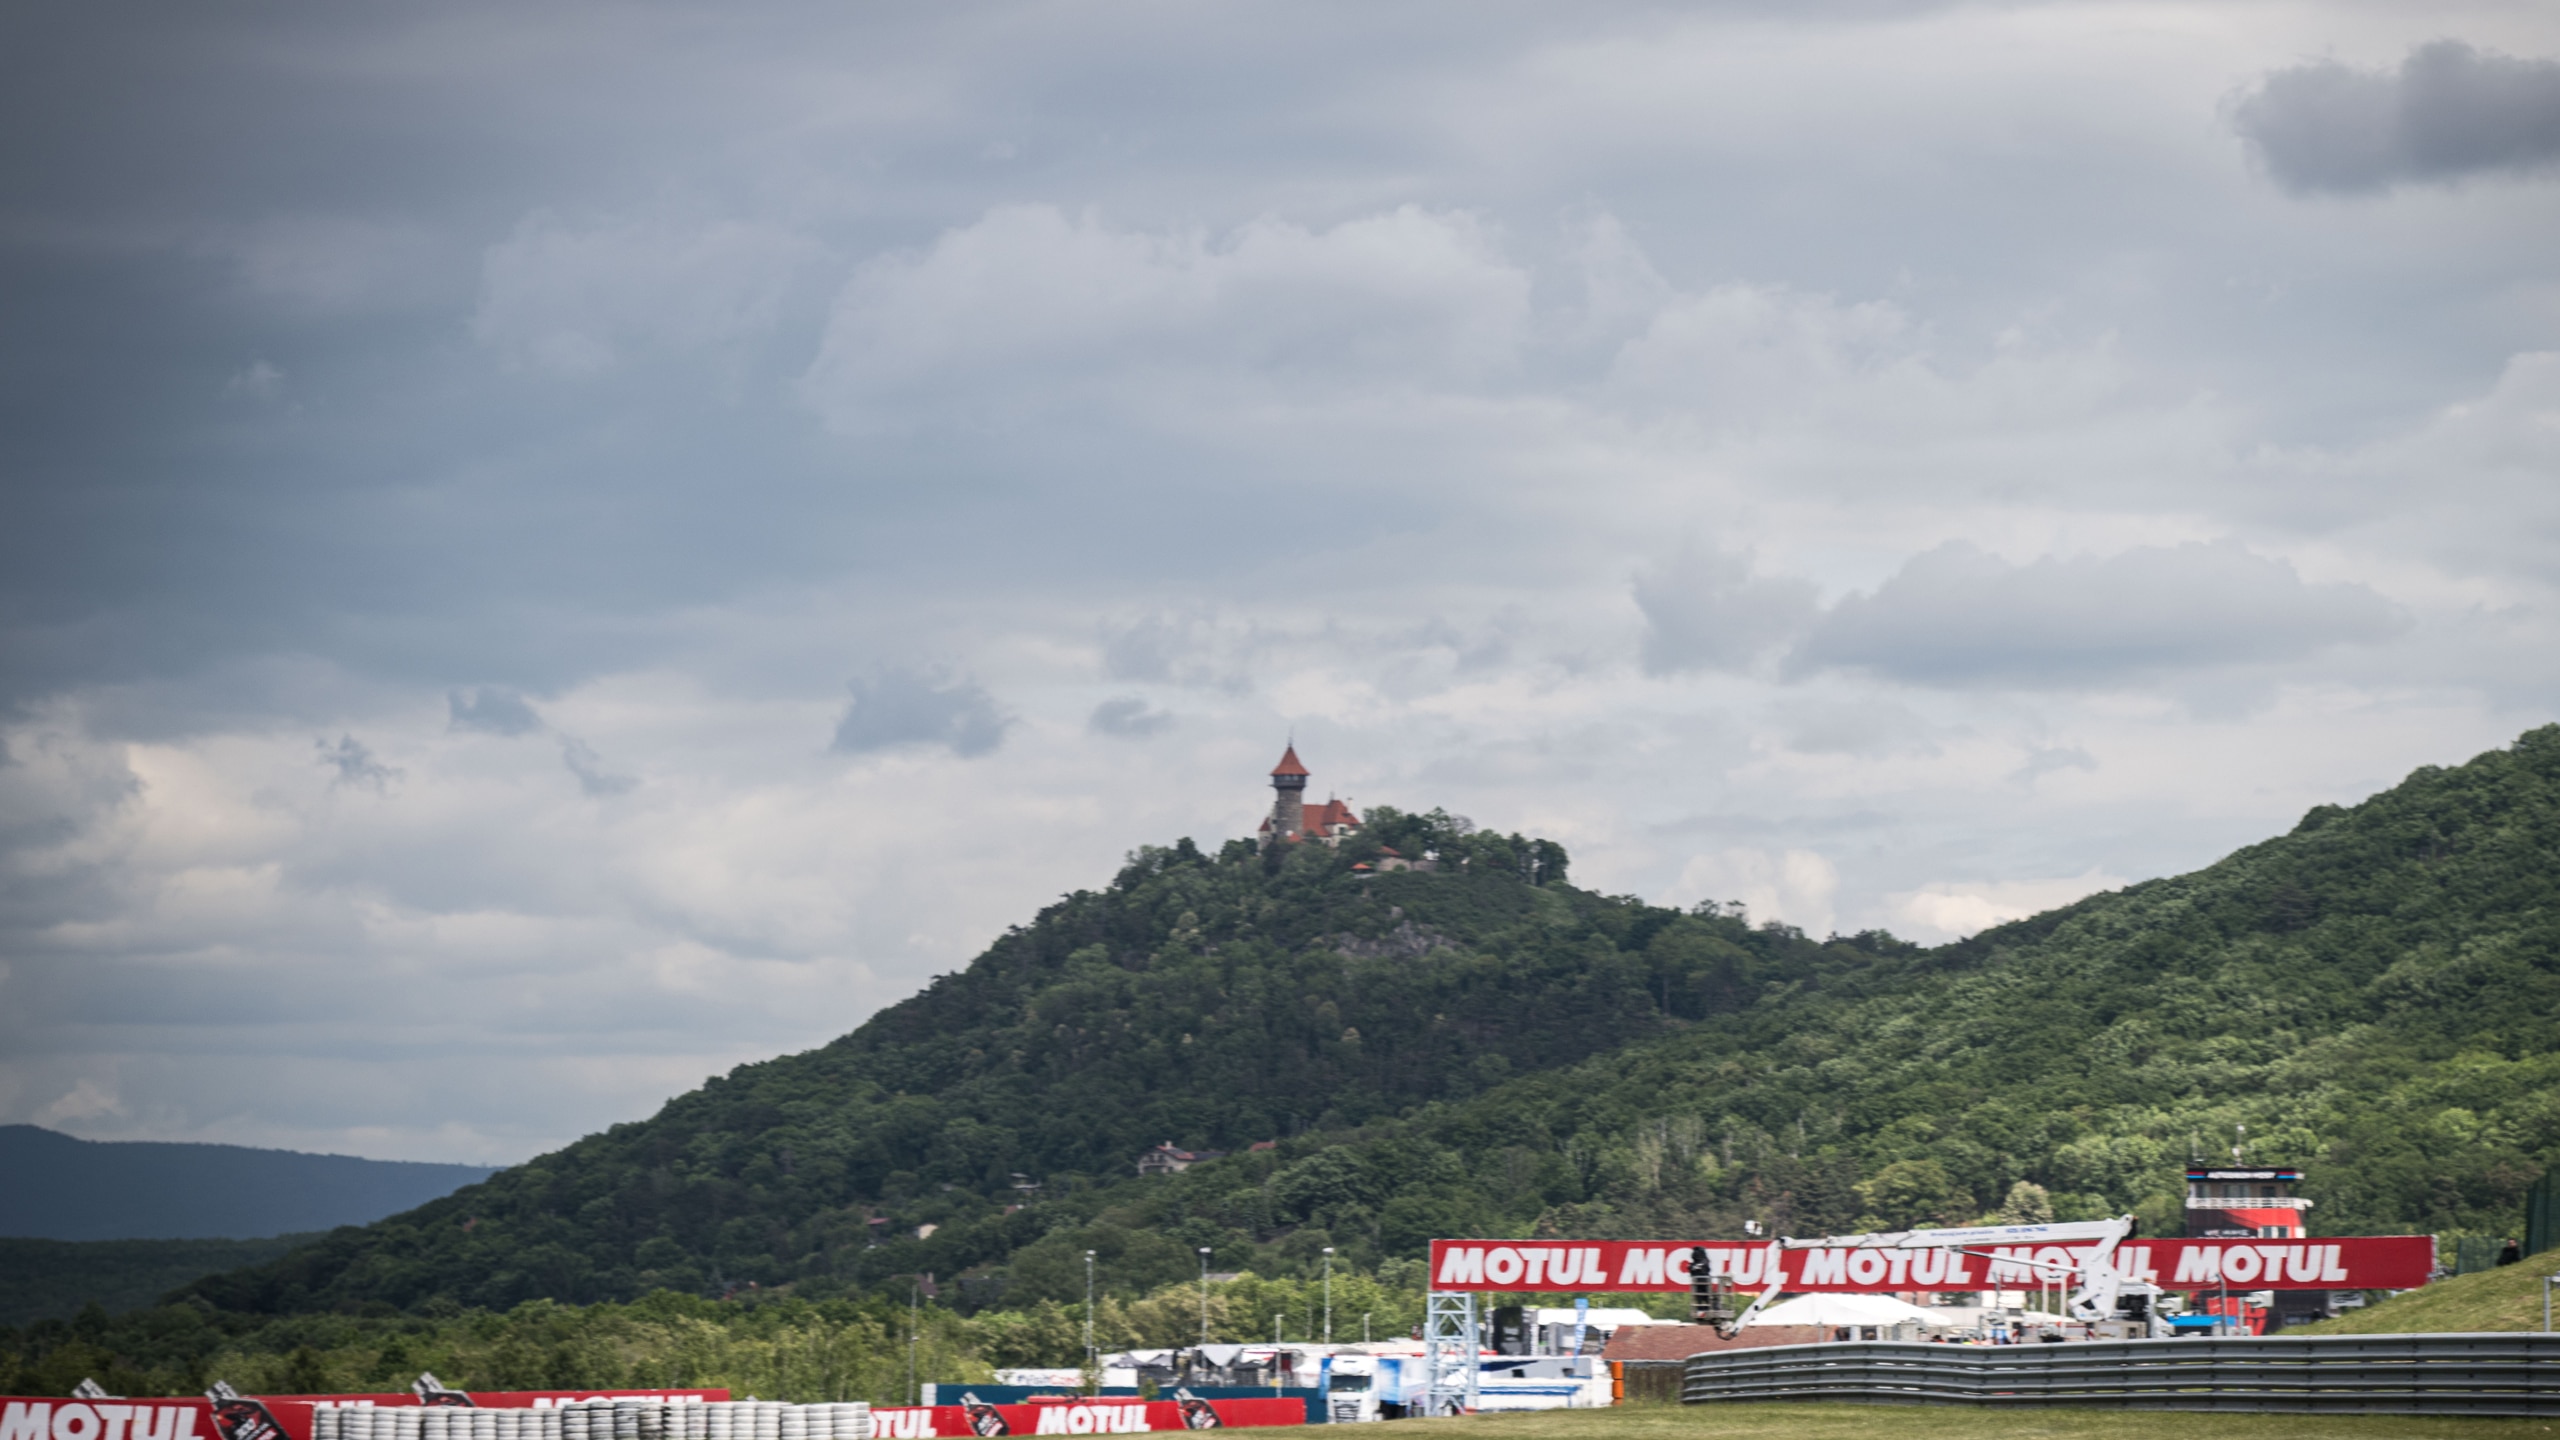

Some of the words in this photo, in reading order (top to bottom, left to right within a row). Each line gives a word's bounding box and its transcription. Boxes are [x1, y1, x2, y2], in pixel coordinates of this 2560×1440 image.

[1438, 1247, 1607, 1284] MOTUL
[1800, 1247, 1973, 1285] MOTUL
[2173, 1245, 2349, 1283] MOTUL
[0, 1401, 205, 1440] MOTUL
[868, 1409, 937, 1438] TUL
[1035, 1404, 1152, 1435] MOTUL
